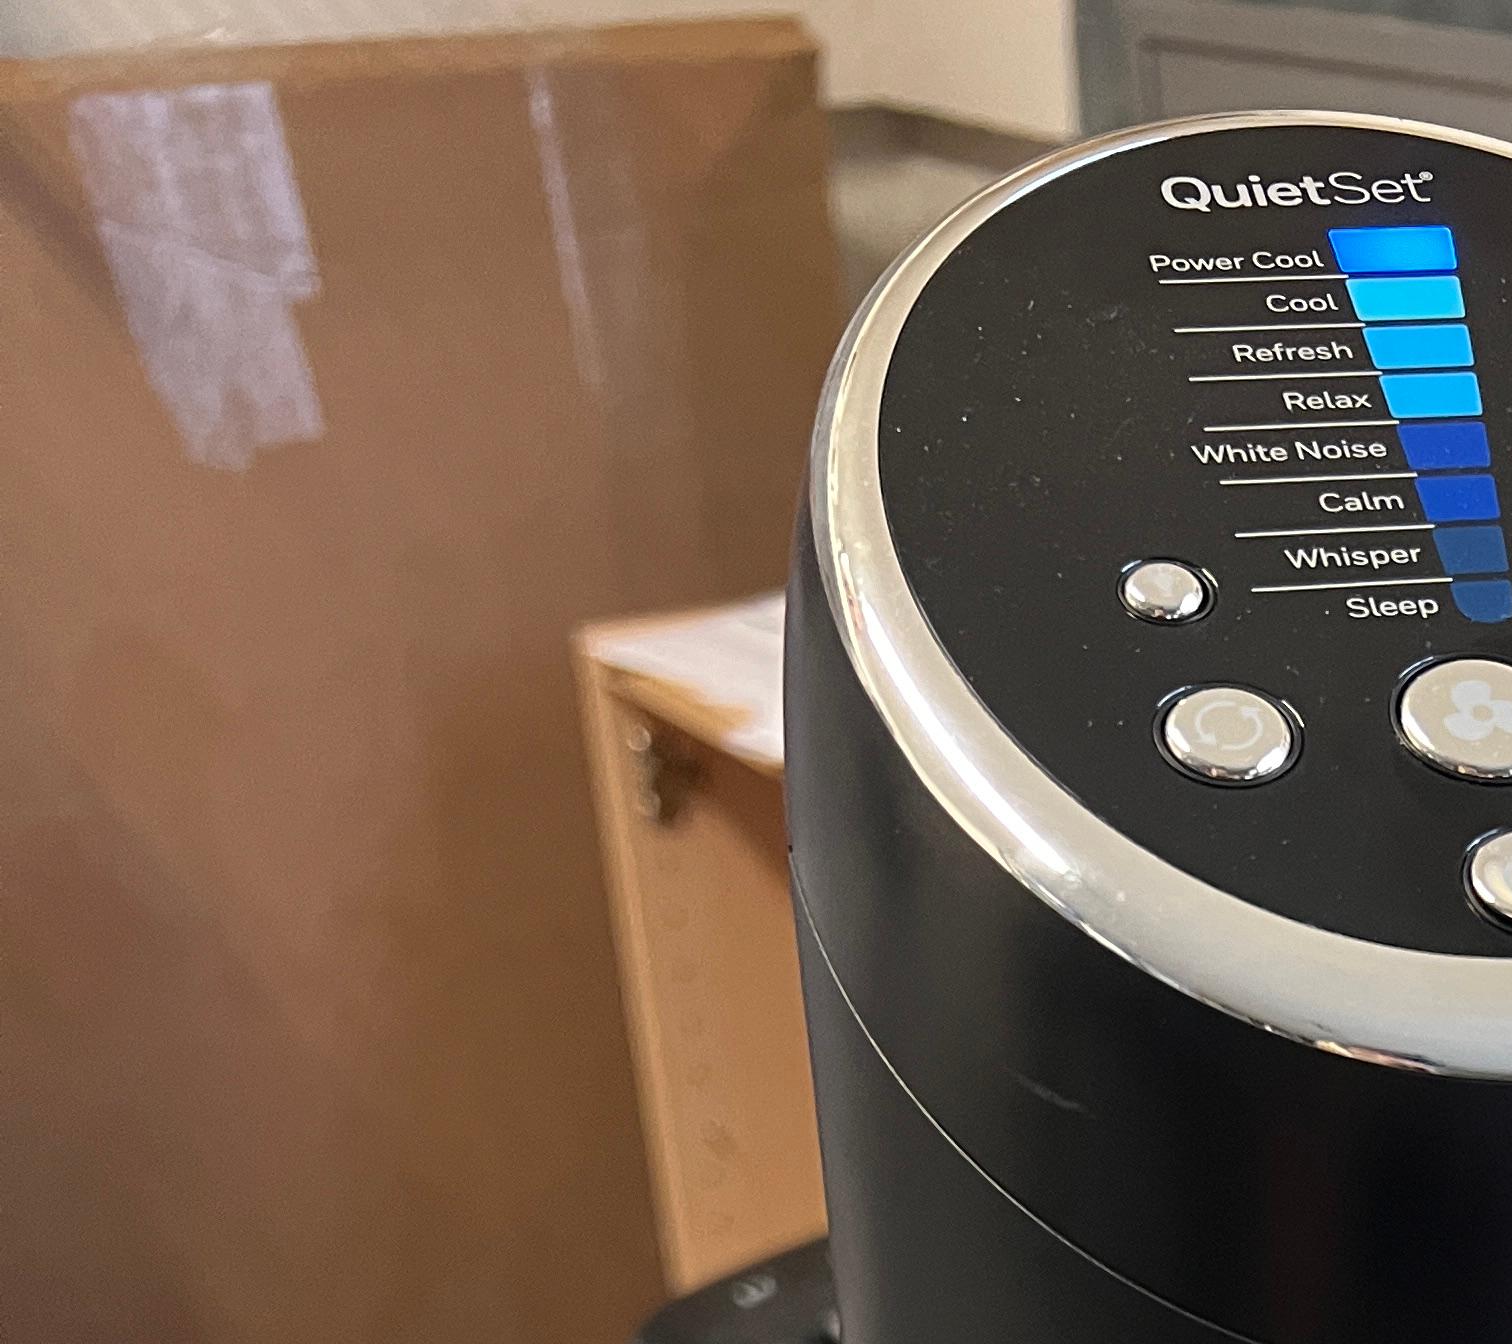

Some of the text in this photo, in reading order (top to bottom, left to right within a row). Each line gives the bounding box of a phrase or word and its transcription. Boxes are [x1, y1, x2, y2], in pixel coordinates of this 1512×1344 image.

[1148, 249, 1325, 273] Power Cool
[1265, 293, 1339, 313] Cool
[1231, 341, 1354, 363] Refresh
[1282, 390, 1373, 412] Relax
[1190, 439, 1387, 464] White Noise
[1318, 491, 1405, 513] Calm
[1283, 546, 1421, 570] Whisper
[1345, 596, 1439, 619] Sleep
